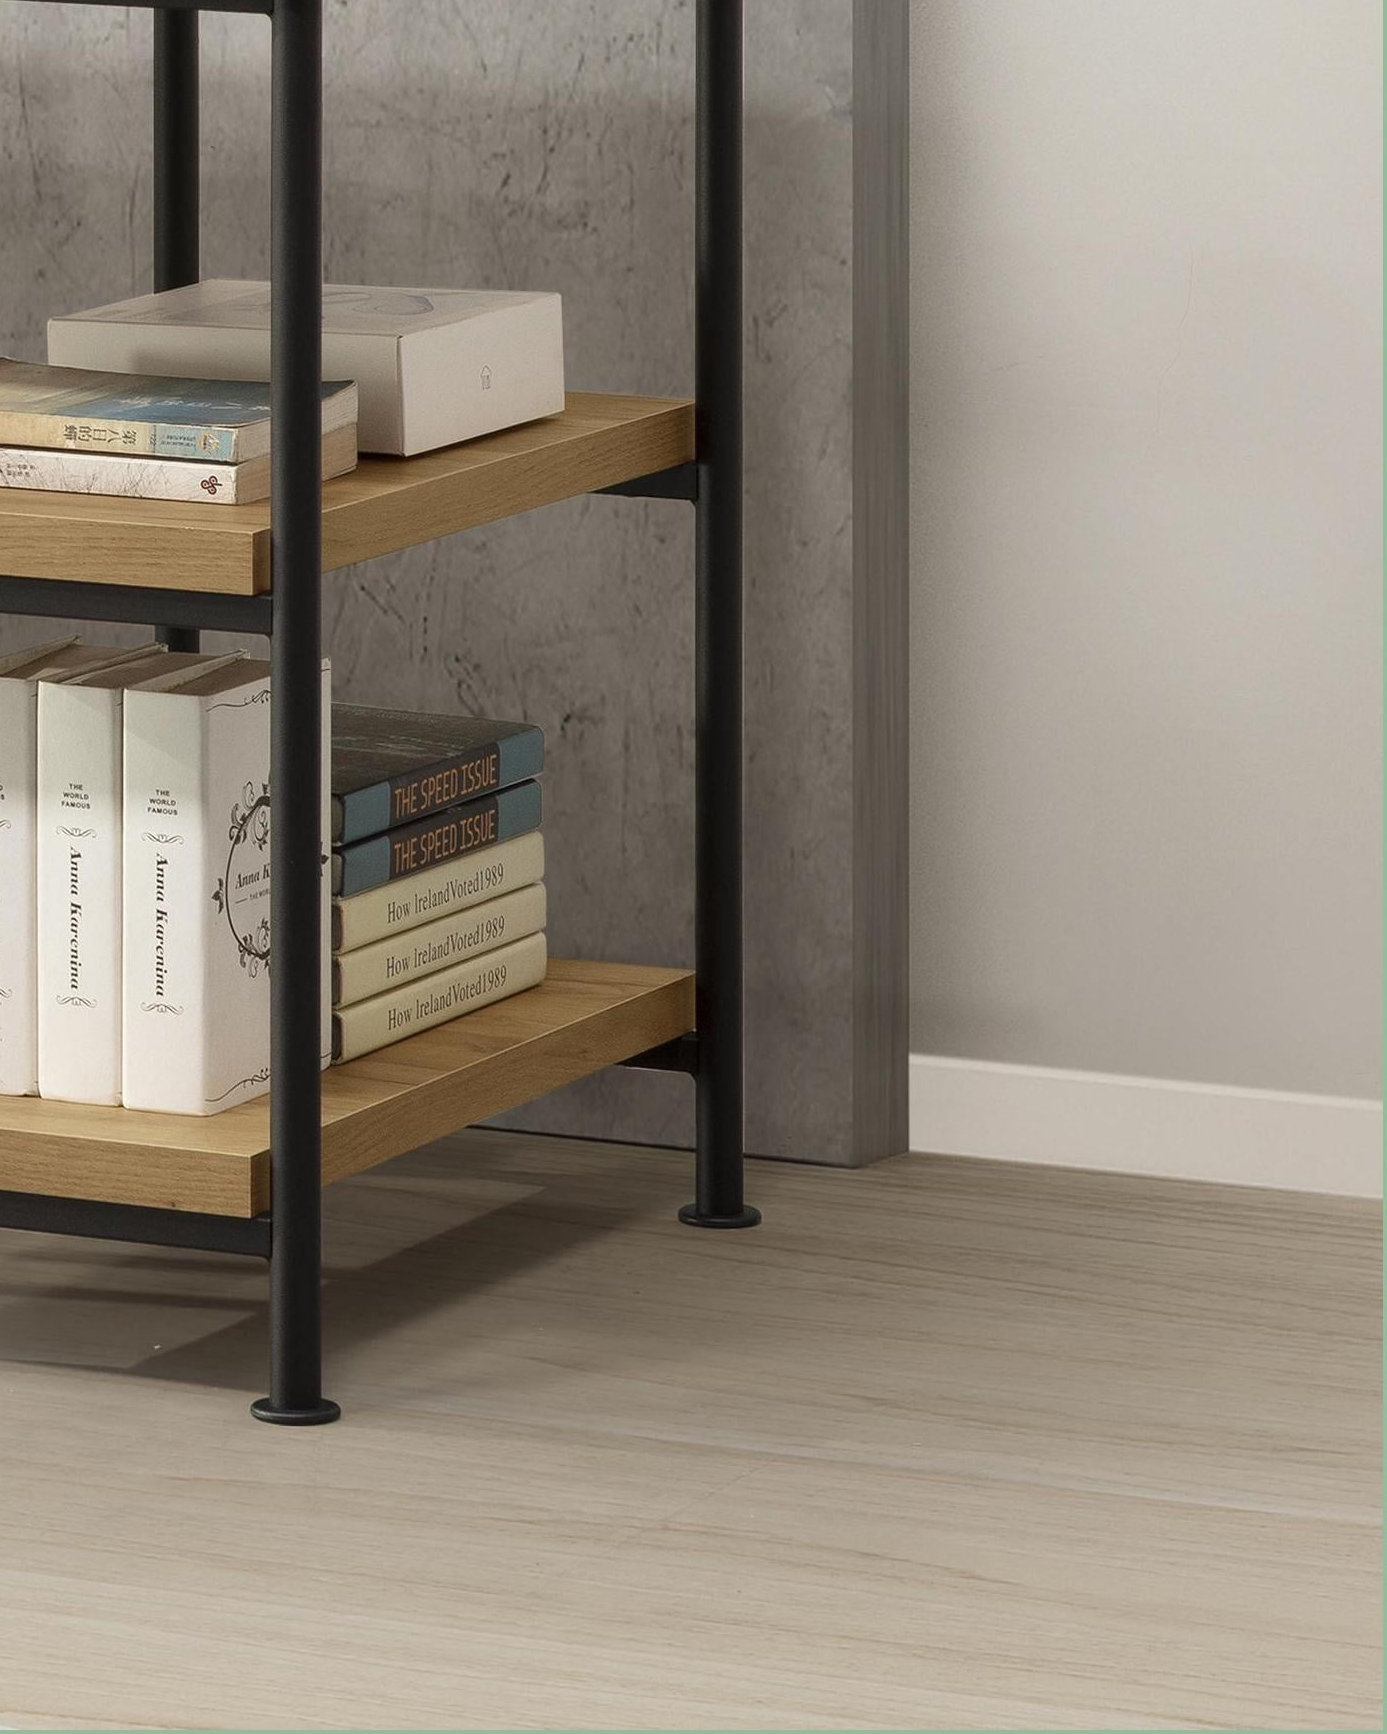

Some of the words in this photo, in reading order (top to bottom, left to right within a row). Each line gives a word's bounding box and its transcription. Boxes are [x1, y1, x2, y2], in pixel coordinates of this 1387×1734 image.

[63, 792, 89, 800] WORLD
[69, 783, 83, 791] THE
[156, 789, 170, 797] THE
[394, 783, 418, 818] THE
[421, 769, 458, 810] SPEED
[461, 754, 497, 795] ISSUE
[61, 801, 91, 810] FAMOUS
[147, 807, 178, 816] FAMOUS
[149, 798, 176, 807] WORLD
[394, 837, 417, 874] THE
[420, 824, 457, 865] SPEED
[460, 810, 495, 849] ISSUE
[70, 846, 82, 895] Anna
[156, 852, 168, 902] Anna
[234, 871, 260, 890] Anna
[387, 902, 411, 923] How
[70, 902, 82, 989] Karenina
[155, 908, 168, 996] Karenina
[386, 956, 410, 978] How
[388, 1009, 412, 1030] How
